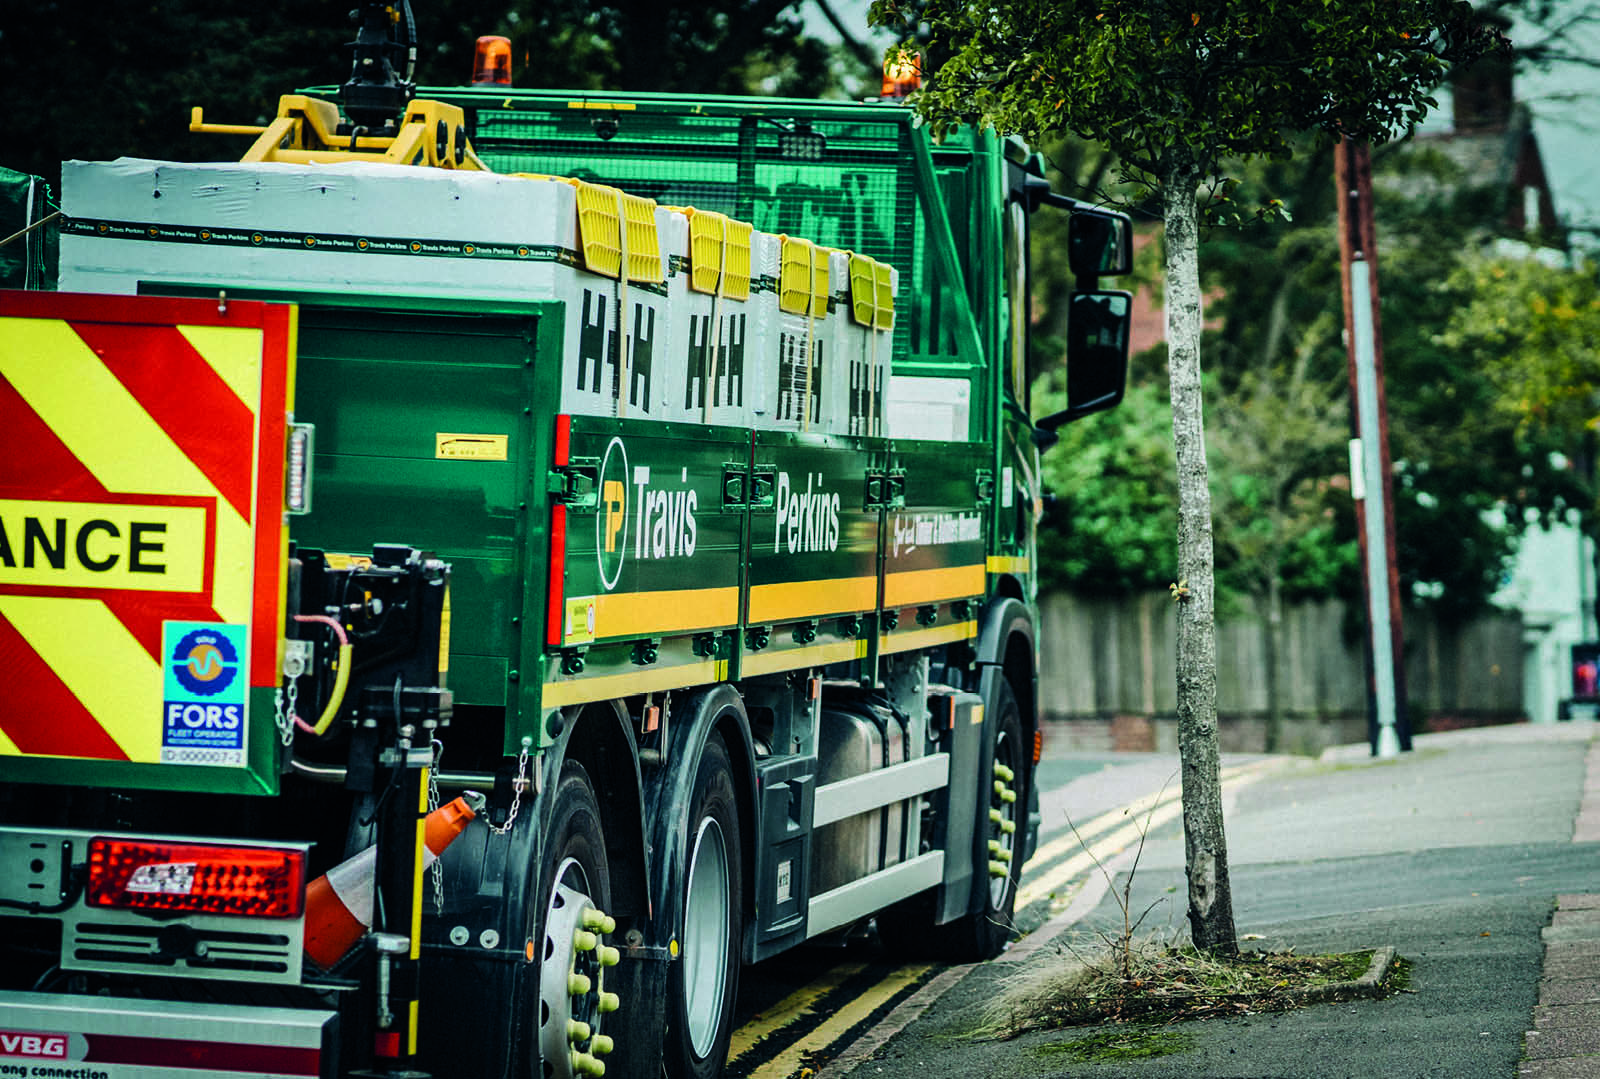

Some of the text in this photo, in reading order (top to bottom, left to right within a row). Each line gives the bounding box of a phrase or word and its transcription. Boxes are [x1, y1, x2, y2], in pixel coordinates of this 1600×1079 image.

[633, 465, 698, 560] Travis
[774, 471, 841, 554] Perkins
[168, 704, 239, 729] FORS
[0, 1035, 64, 1056] VBG
[31, 1067, 108, 1079] connection
